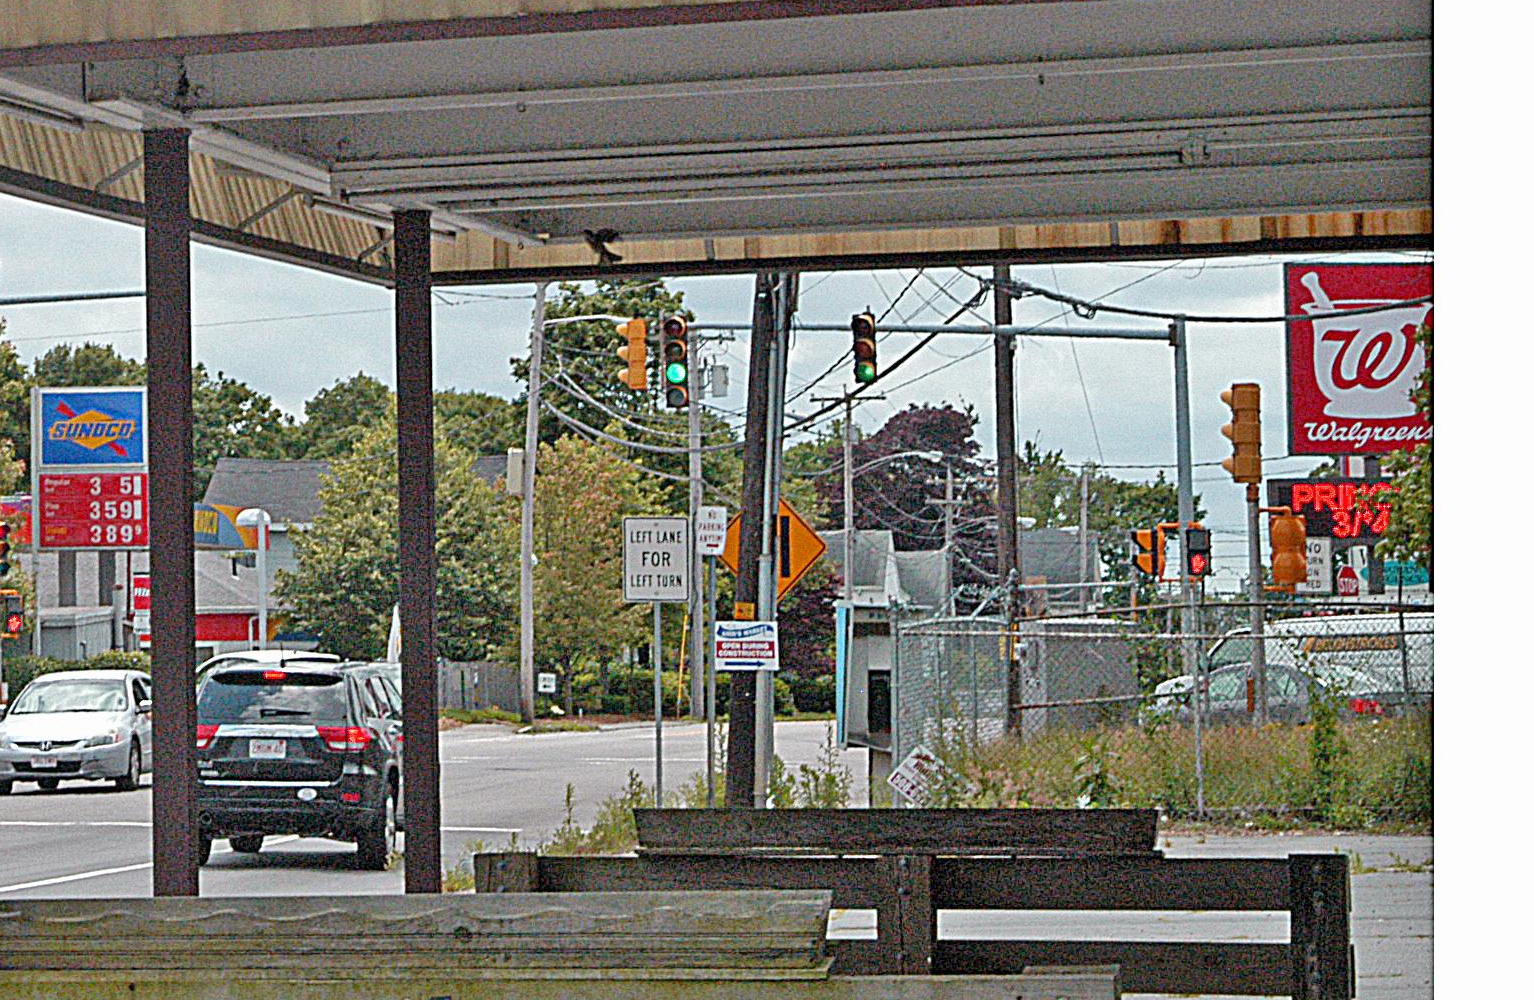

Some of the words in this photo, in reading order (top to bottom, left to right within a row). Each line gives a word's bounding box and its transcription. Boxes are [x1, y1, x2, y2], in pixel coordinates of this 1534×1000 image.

[53, 422, 133, 438] SUNOCO
[1304, 421, 1433, 448] Walgreens
[89, 501, 133, 520] 359
[90, 525, 133, 543] 389
[631, 531, 652, 543] LEFT
[657, 531, 682, 543] LANE
[642, 552, 671, 567] FOR
[631, 575, 652, 587] LEFT
[657, 574, 682, 587] TURN
[1339, 577, 1359, 593] STOP
